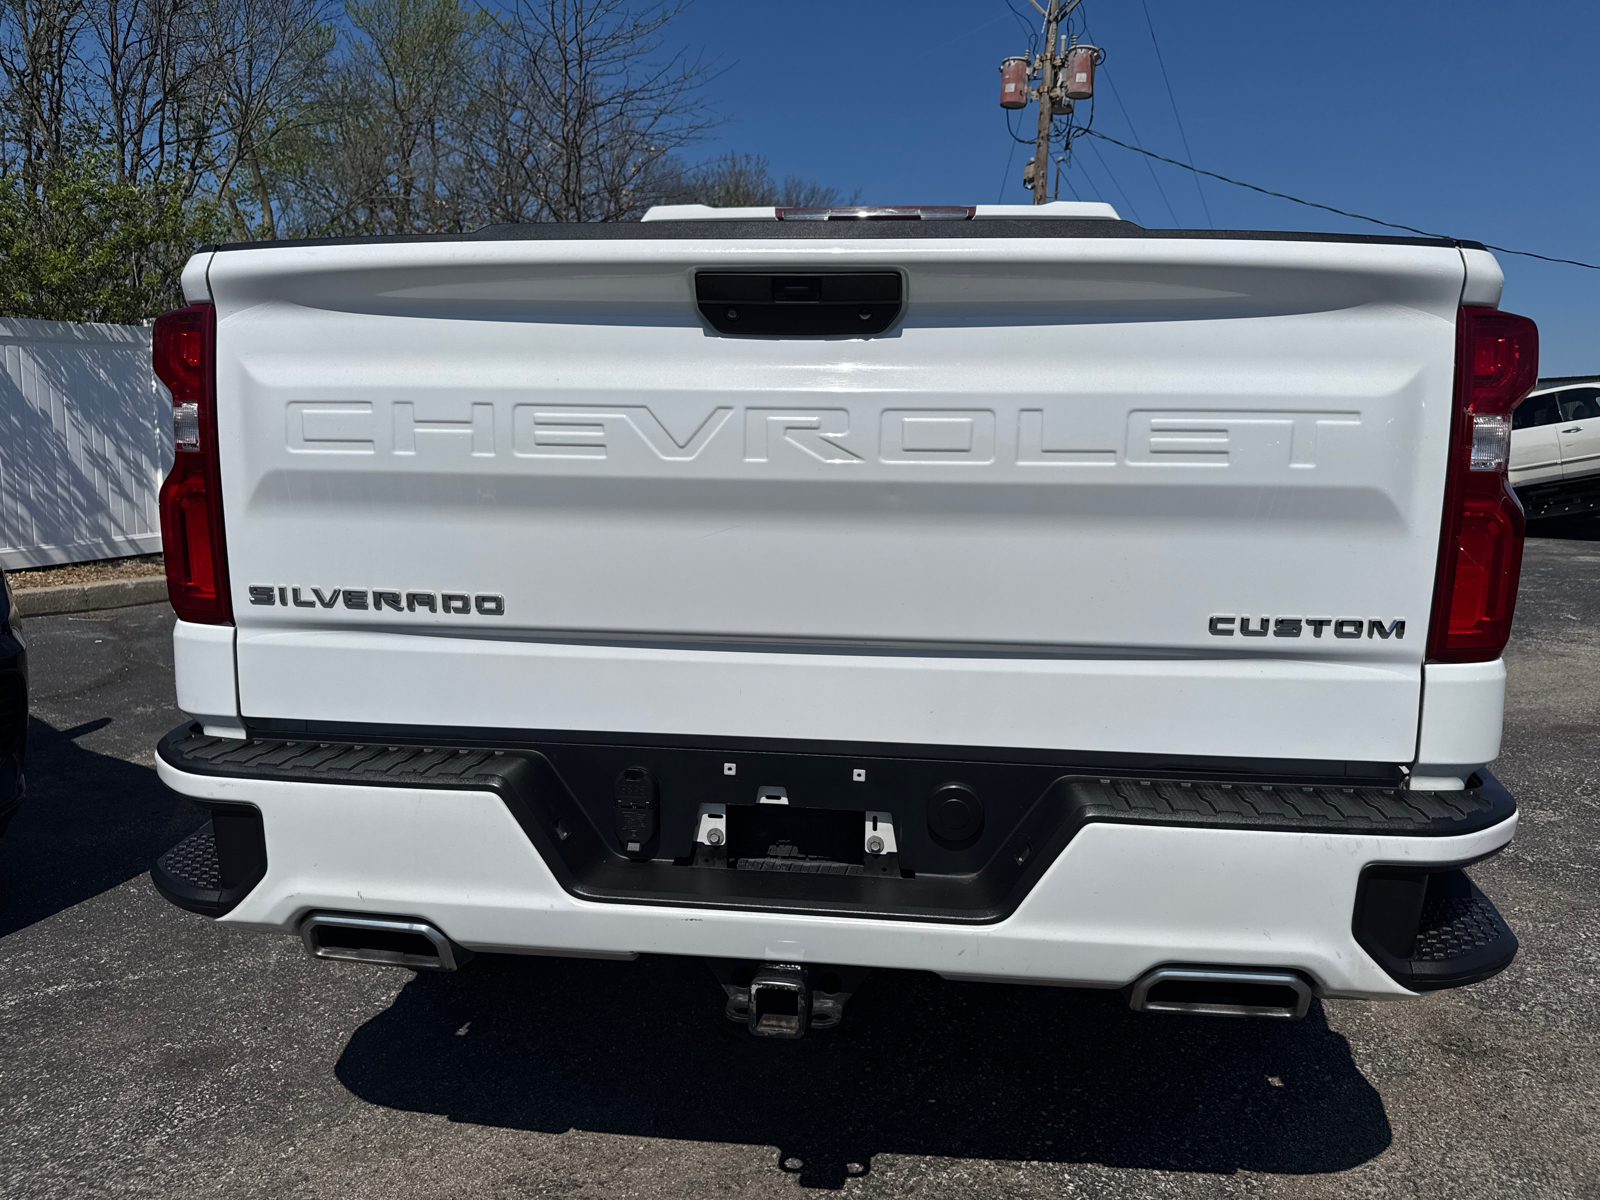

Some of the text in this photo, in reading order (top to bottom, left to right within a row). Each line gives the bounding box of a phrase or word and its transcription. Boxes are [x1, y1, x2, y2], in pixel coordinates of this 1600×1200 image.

[285, 401, 1361, 468] CHEVROLET
[248, 584, 505, 615] SILVERADO
[1208, 613, 1406, 639] CUSTOM
